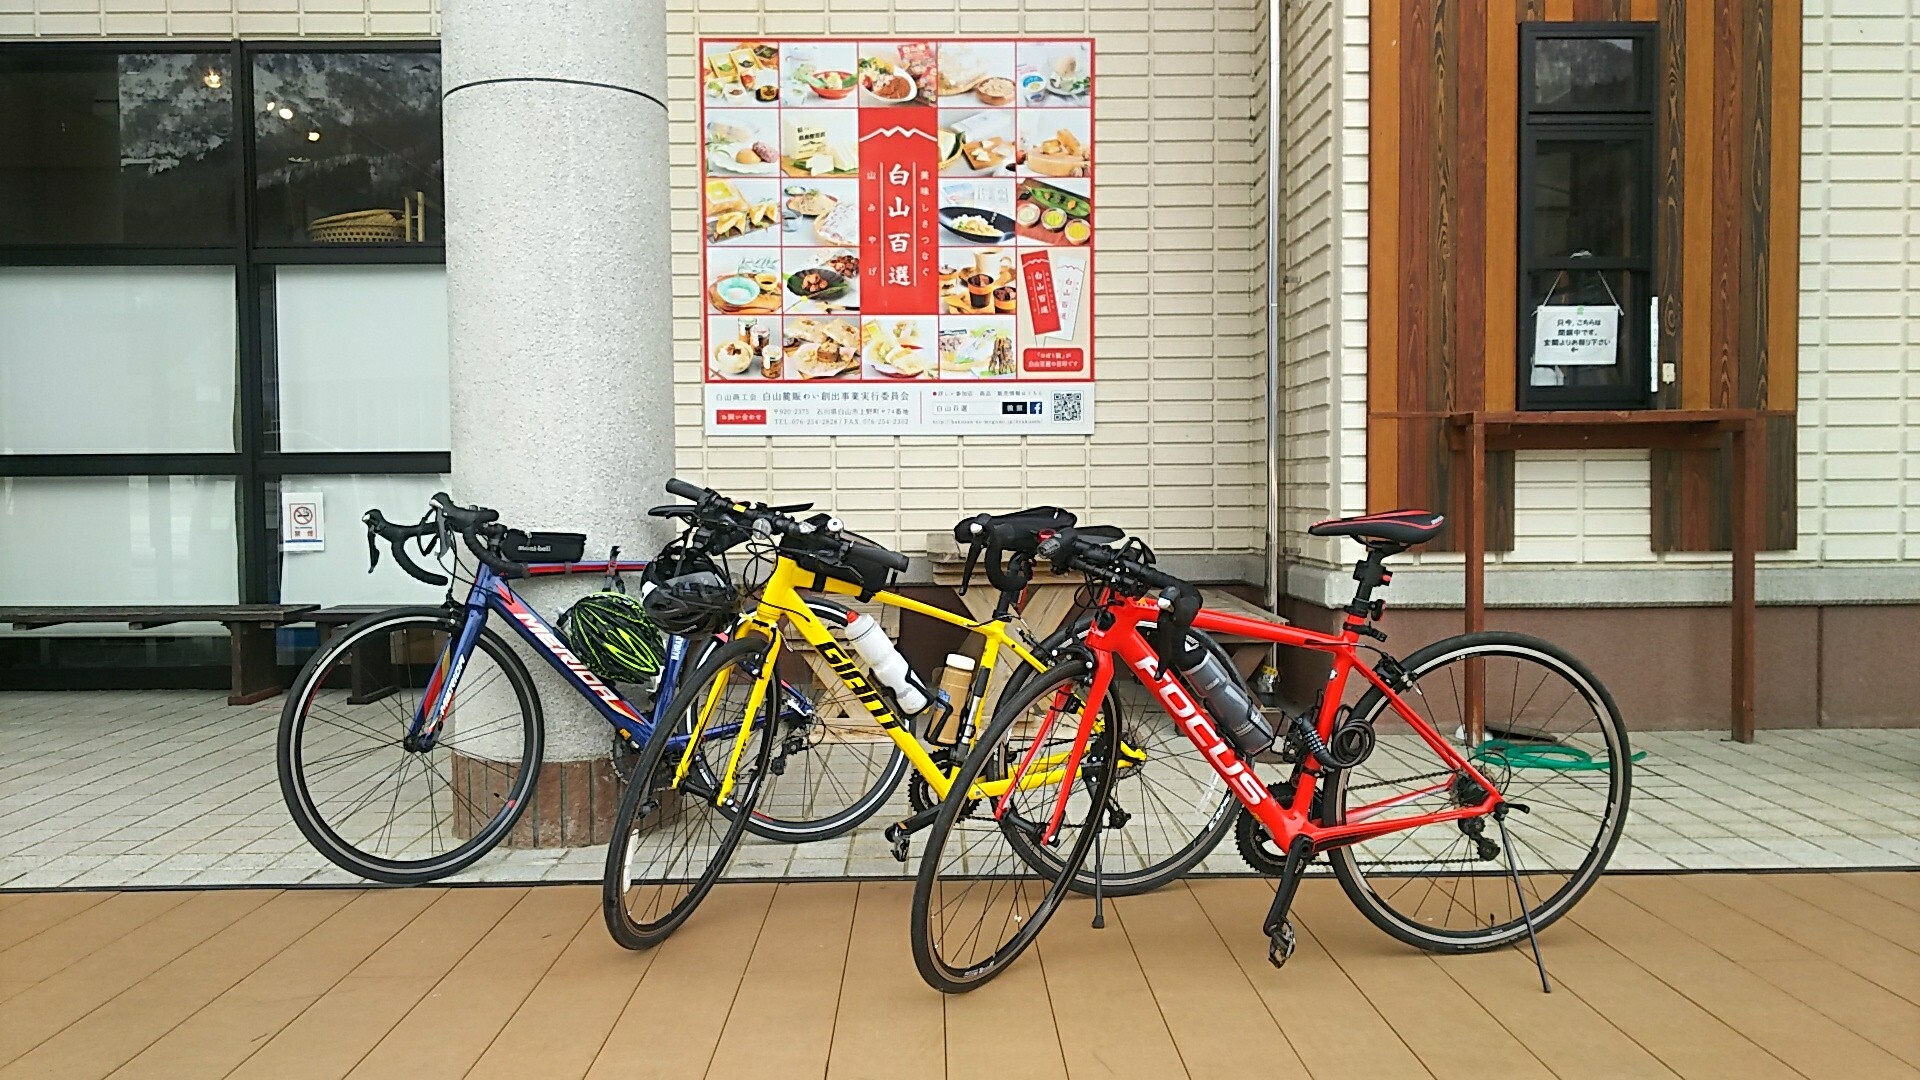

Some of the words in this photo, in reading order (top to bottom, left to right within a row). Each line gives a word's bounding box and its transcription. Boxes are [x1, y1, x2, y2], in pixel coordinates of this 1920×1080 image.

[866, 170, 878, 277] 山みやげ
[888, 163, 911, 286] 白山百選
[513, 613, 620, 701] MERIDA
[815, 641, 910, 733] GIANT
[1134, 655, 1268, 805] FOCUS
